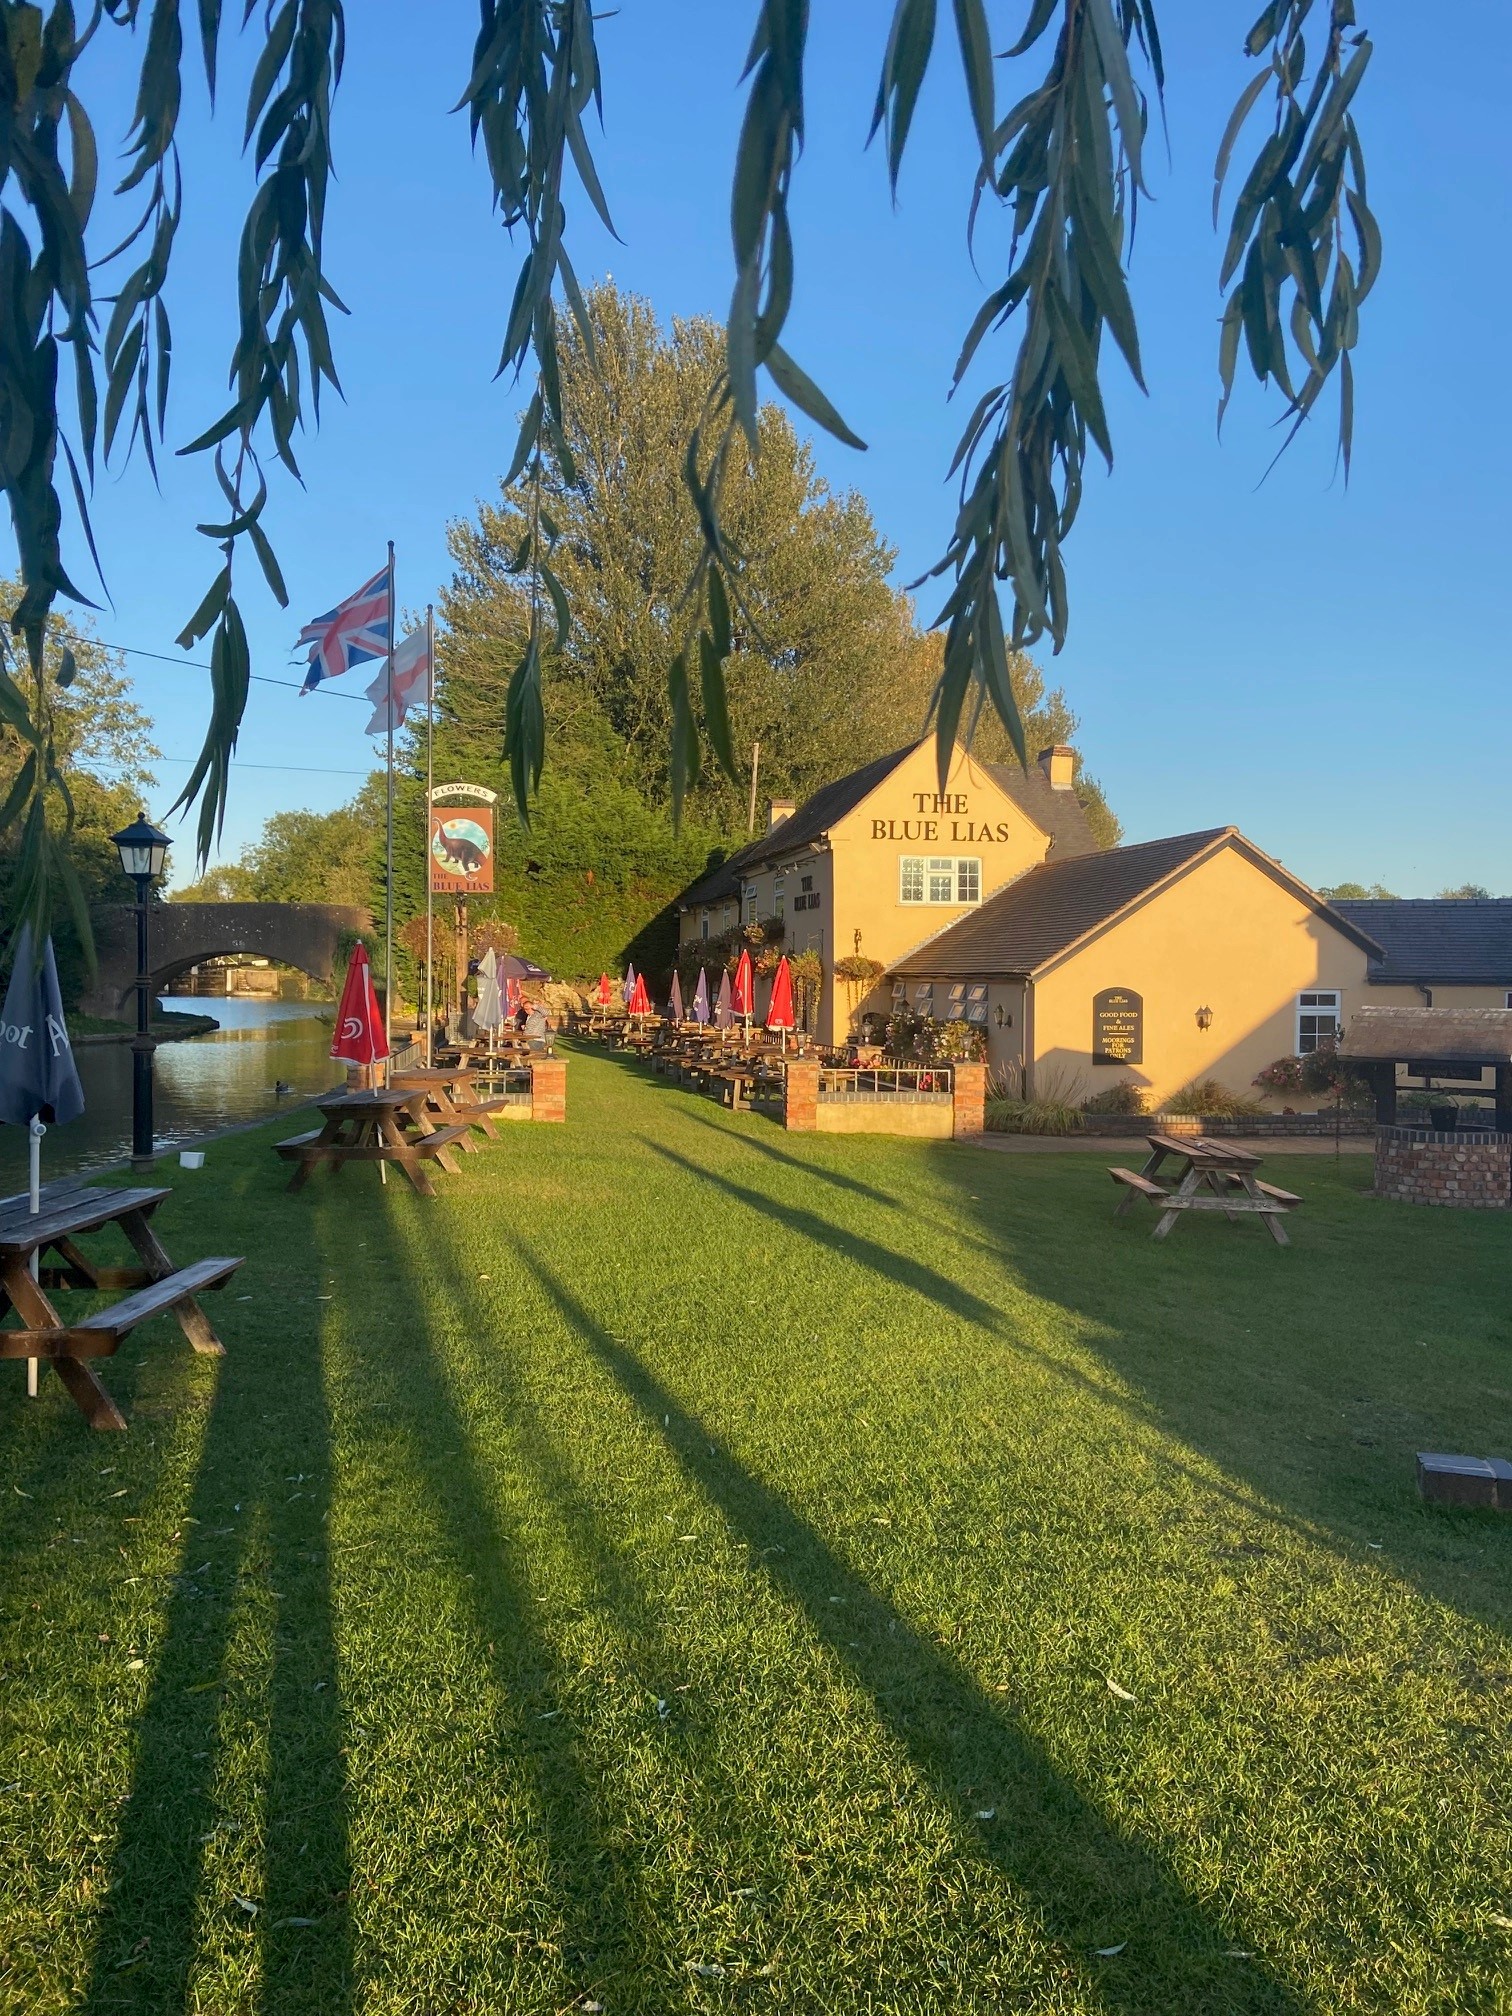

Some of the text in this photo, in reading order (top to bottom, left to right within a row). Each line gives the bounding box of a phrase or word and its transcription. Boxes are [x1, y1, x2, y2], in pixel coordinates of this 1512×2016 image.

[434, 785, 488, 798] FLOWERS
[912, 793, 969, 815] THE
[871, 819, 1009, 843] BLUE LIAS
[433, 882, 490, 891] BLUE LIAS
